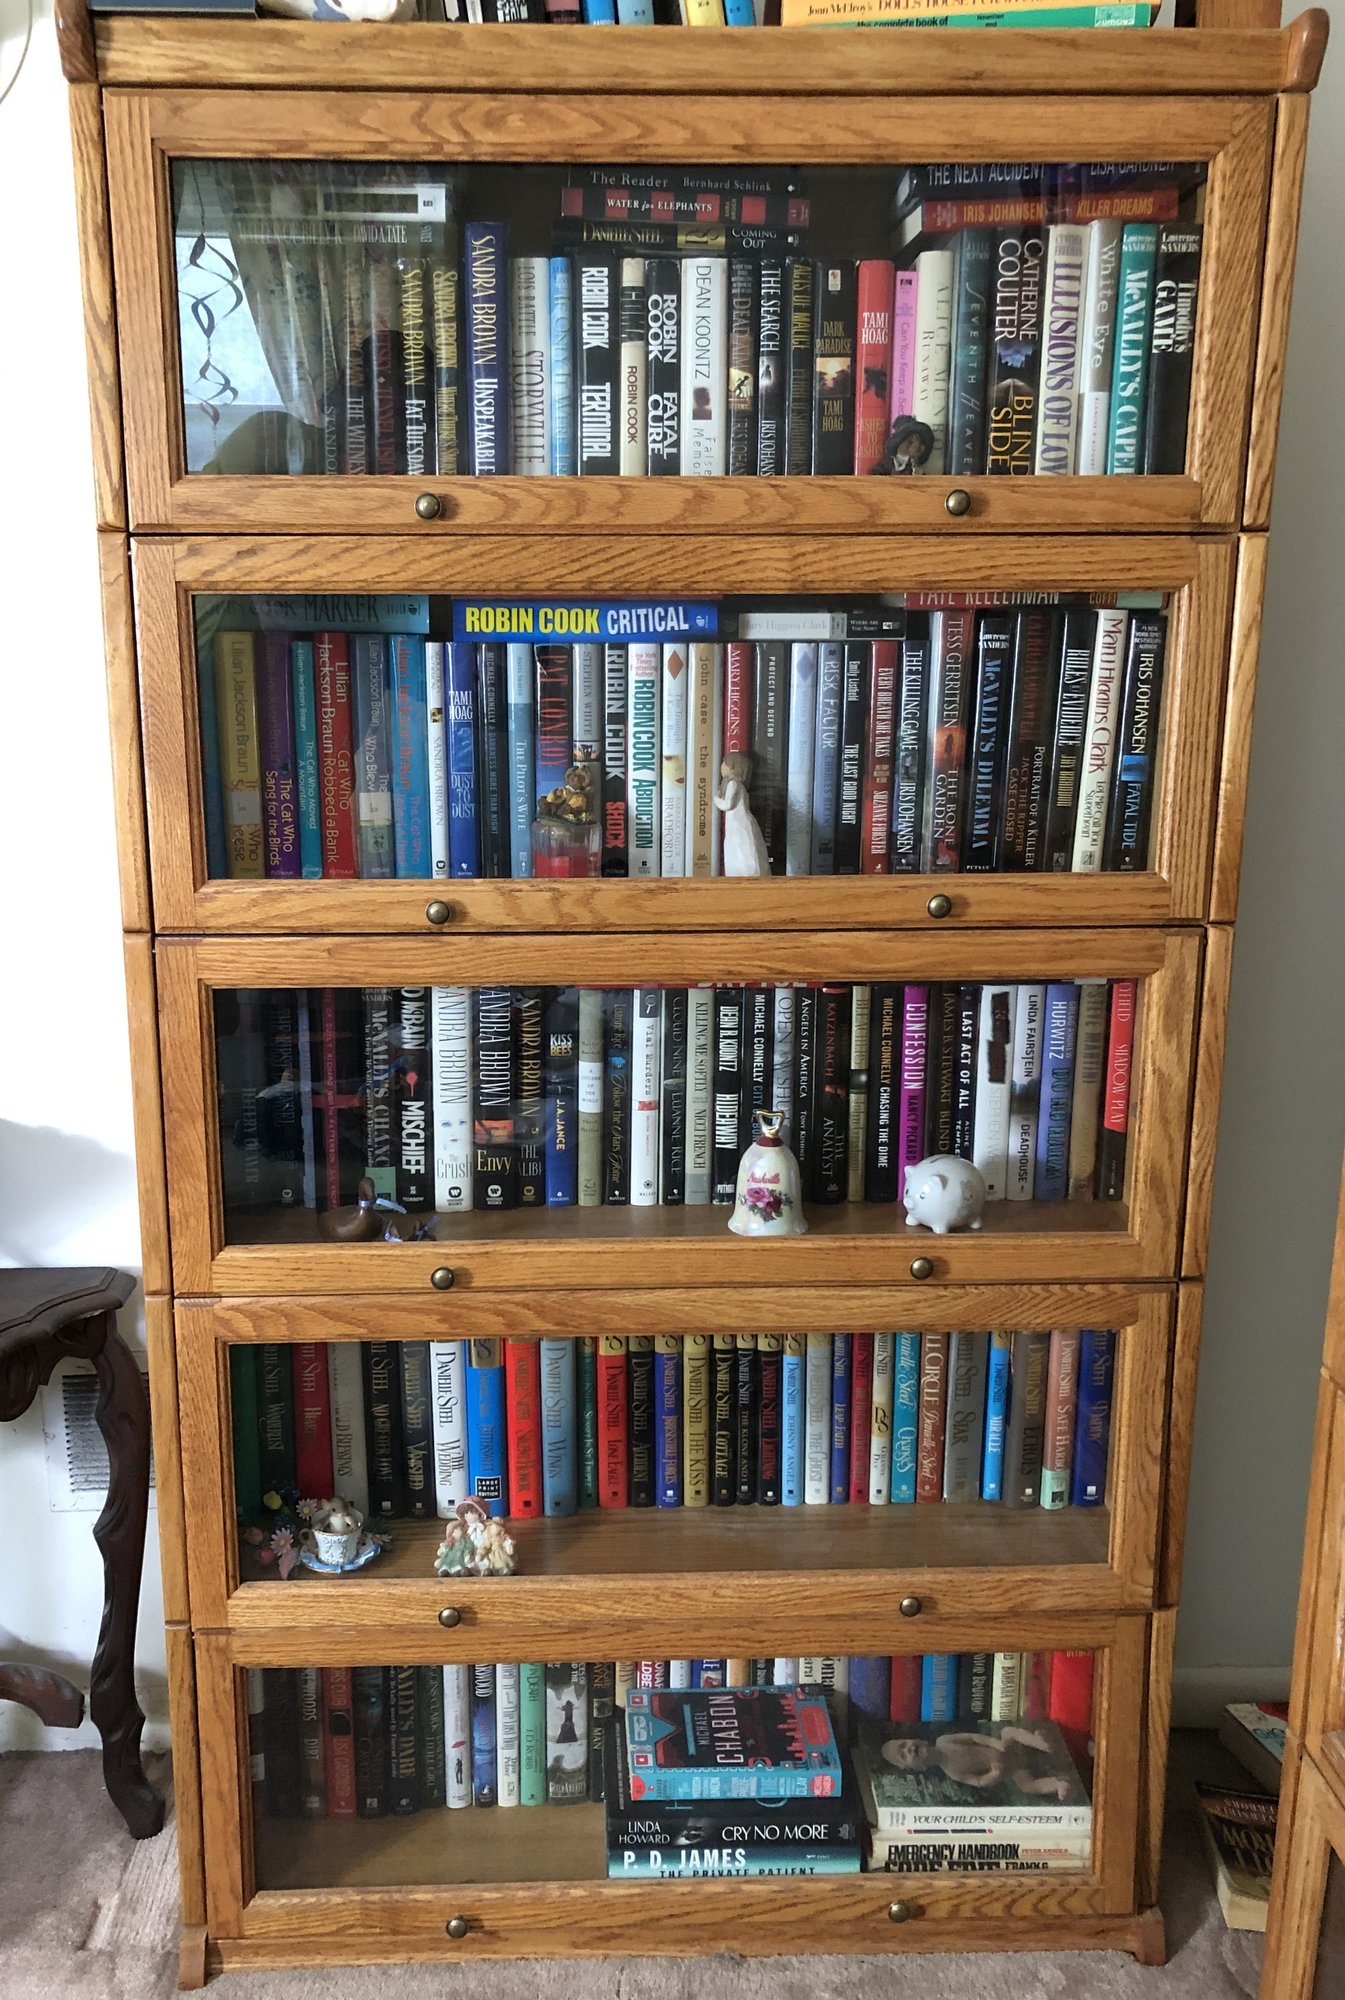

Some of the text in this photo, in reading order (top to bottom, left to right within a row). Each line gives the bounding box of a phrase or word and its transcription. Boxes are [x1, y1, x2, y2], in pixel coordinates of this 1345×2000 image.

[916, 18, 935, 27] book
[591, 171, 772, 192] The Reader Bernhard Schlink
[964, 198, 1154, 221] IRIS JOHANSEN KILLER DREAMS
[732, 227, 776, 239] COMING
[743, 238, 766, 248] OUT
[433, 271, 458, 368] SANDRA BROWN
[695, 265, 711, 379] DEAN KOONTZ
[760, 268, 781, 351] THE SEARCH
[862, 313, 888, 328] TAMI
[994, 239, 1021, 342] COULTER
[1019, 239, 1044, 341] CATHERINE
[1151, 280, 1177, 354] GAME
[471, 235, 498, 473] SANDRA BROWN UNSPEAKABLE
[648, 294, 662, 361] COOK
[663, 294, 677, 363] ROBIN
[861, 328, 888, 344] HOAG
[1043, 261, 1083, 427] ILLUSIONS OF
[401, 269, 427, 476] SANDRA BROWN FAT TUESDAY
[512, 266, 545, 464] LOIS BATTLE STORYVILLE
[582, 268, 611, 461] ROBIN COOK TERMINAL
[627, 366, 638, 444] ROBIN COOK
[648, 394, 663, 455] CURE
[663, 392, 678, 459] FATAL
[822, 400, 843, 415] TAMI
[989, 407, 1012, 468] SIDE
[466, 606, 689, 634] ROBIN COOK CRITICAL
[944, 618, 963, 728] TESS GERRITSEN
[539, 654, 568, 767] PAT CONROY
[337, 750, 351, 809] Cat Who
[605, 649, 625, 848] ROBIN COOK SHOCK
[632, 679, 657, 848] ROBIN COOK ABDUCTION
[697, 657, 709, 836] john case the syndrome
[896, 650, 922, 853] THE KILLING GAME IRIS JOHANSEN
[972, 658, 1001, 848] McNALLY'S DILEMMA
[1122, 653, 1154, 850] IRIS JOHANSEN FATAL TIDE
[280, 778, 294, 852] The Cat Who
[516, 740, 528, 831] THE PILOT'S WIFE
[842, 744, 858, 824] THE LAST GOOD NIGHT
[934, 774, 947, 839] GARDEN
[944, 768, 958, 845] THE BONE
[519, 999, 542, 1117] SANDRA BROWN
[753, 995, 765, 1104] MICHAEL CONNELLY CITY
[904, 1003, 927, 1089] CONFESSION
[959, 1011, 972, 1109] LAST ACT OF ALL
[1049, 1001, 1067, 1059] HURWITZ
[439, 1049, 467, 1104] BROWN
[878, 998, 893, 1168] MICHAEL CONNELLY CHASING THE DIME
[1110, 1044, 1128, 1124] SHADOW PLAY
[401, 1101, 425, 1174] MISCHIEF
[715, 1093, 738, 1149] HIDEAWAY
[822, 1117, 834, 1178] ANALYST
[476, 1150, 512, 1175] Envy
[435, 1352, 458, 1428] DANIELLE STEEL
[688, 1357, 707, 1486] DANIELLE STEEL THE KISS
[921, 1352, 944, 1483] CIRCLE Danielle Steel
[1056, 1405, 1072, 1432] SAFE
[715, 1431, 729, 1478] COTTAGE
[989, 1415, 1003, 1454] MIRACLE
[786, 1455, 794, 1485] ANGEL
[1002, 1666, 1015, 1697] BARBARA
[304, 1739, 318, 1760] DIRT
[400, 1736, 415, 1777] DARE
[525, 1745, 534, 1770] ROBB
[593, 1727, 602, 1750] MAN
[694, 1711, 711, 1746] MICHAEL
[709, 1695, 744, 1763] CHABON
[619, 1833, 670, 1845] HOWARD
[628, 1821, 661, 1833] LINDA
[722, 1824, 828, 1841] CRY NO MORE
[888, 1844, 1020, 1860] EMERGENCY HANDBOOK
[913, 1815, 942, 1824] YOUR
[943, 1815, 986, 1824] CHILD'S
[989, 1815, 1062, 1824] SELF-ESTEEM
[624, 1848, 746, 1870] P. D. JAMES
